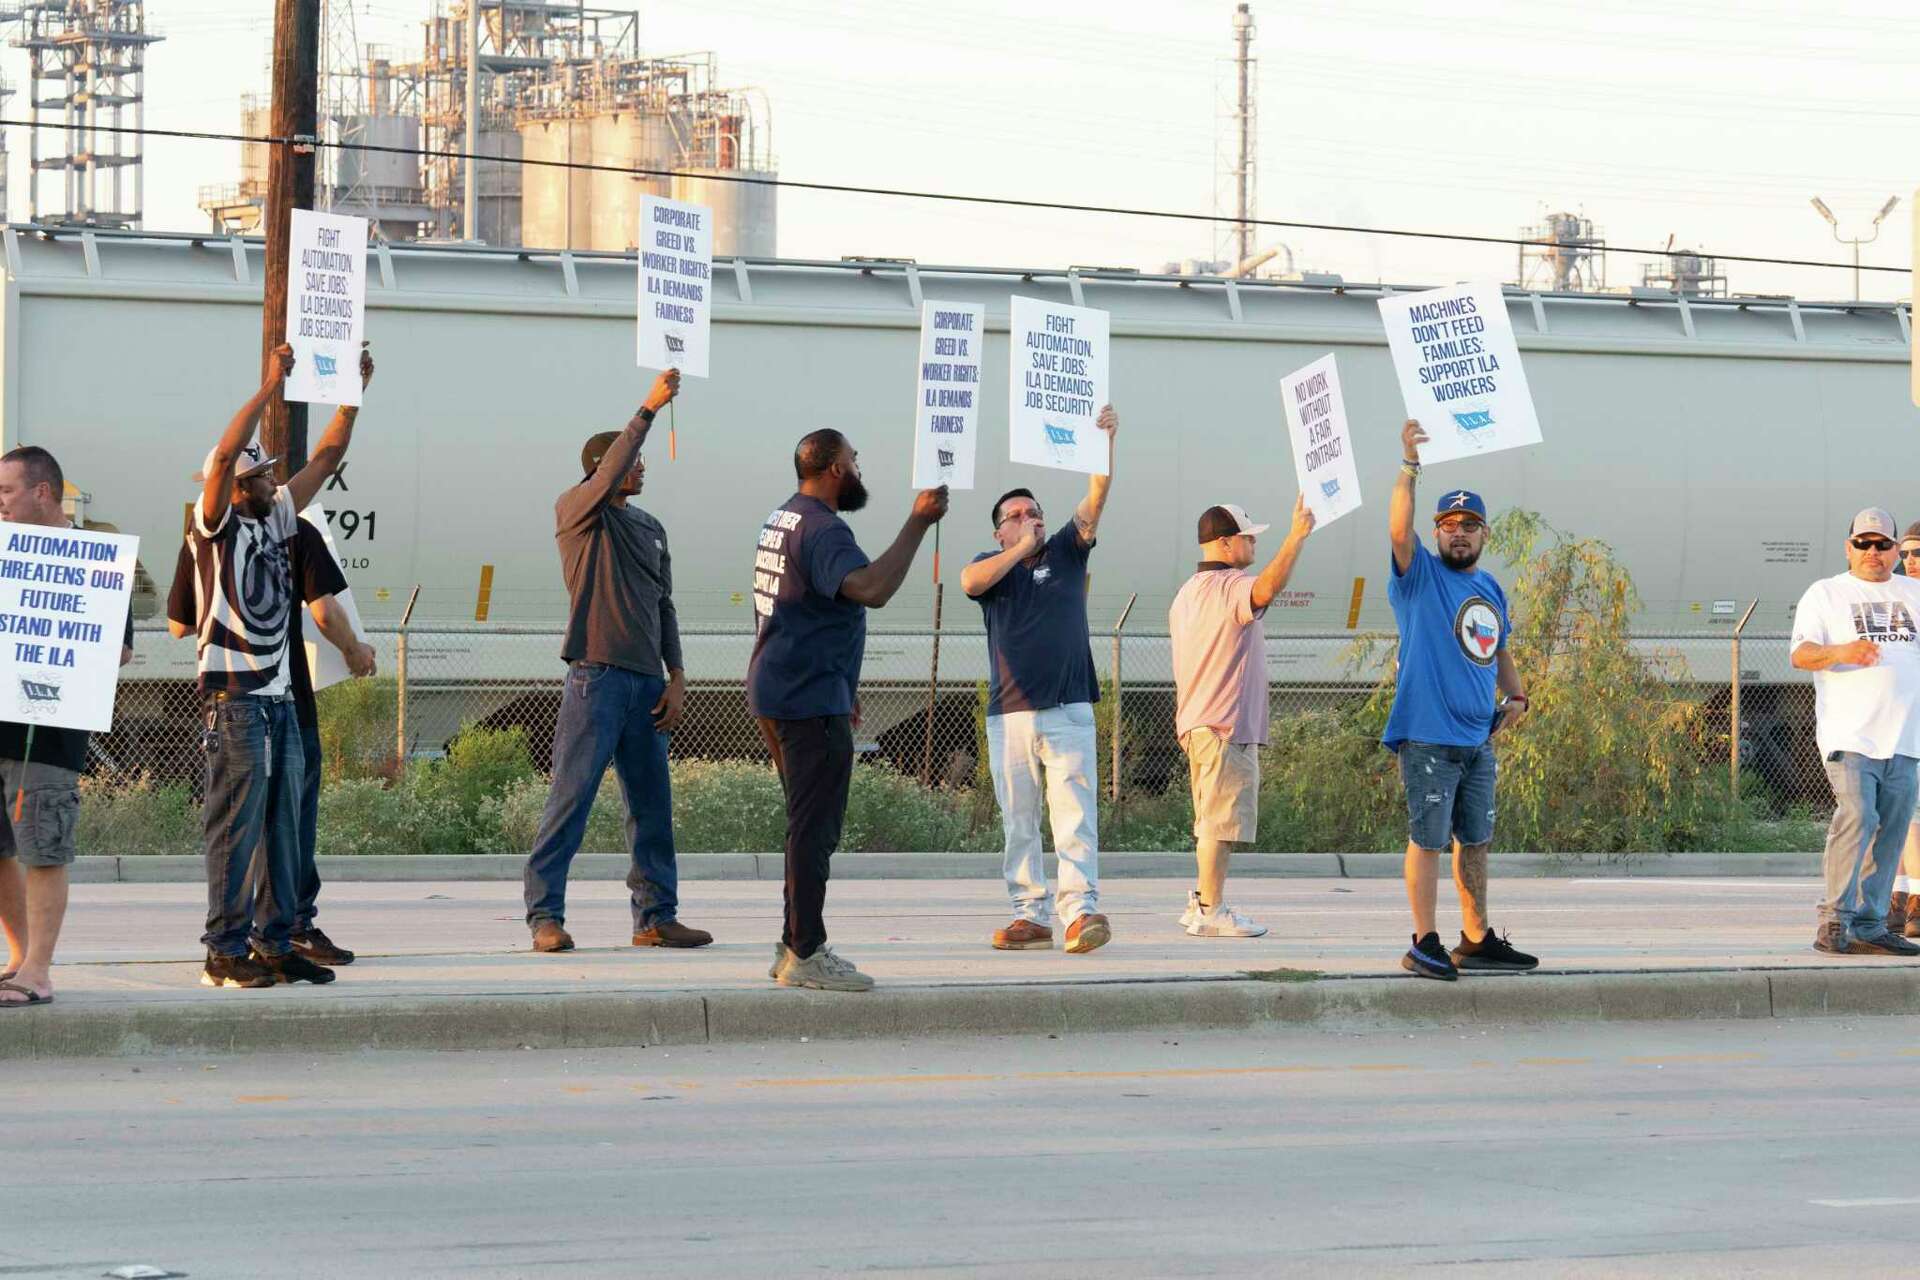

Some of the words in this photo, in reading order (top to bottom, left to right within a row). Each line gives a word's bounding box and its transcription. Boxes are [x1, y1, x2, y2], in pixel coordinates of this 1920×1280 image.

[654, 206, 701, 231] CORPORATE
[317, 228, 340, 247] FIGHT
[656, 230, 681, 251] GREED
[683, 236, 696, 254] VS.
[302, 249, 354, 274] AUTOMATION,
[642, 251, 677, 273] WORKER
[679, 258, 710, 280] RIGHTS:
[305, 272, 326, 293] SAVE
[326, 276, 348, 295] JOBS:
[647, 276, 661, 294] ILA
[663, 279, 703, 302] DEMANDS
[300, 294, 313, 315] ILA
[314, 296, 352, 319] DEMANDS
[655, 302, 694, 324] FAIRNESS
[1409, 296, 1477, 324] MACHINES
[299, 317, 313, 337] JOB
[314, 319, 352, 342] SECURITY
[934, 311, 974, 332] CORPORATE
[1046, 314, 1075, 334] FIGHT
[1411, 322, 1450, 344] DON'T
[1451, 315, 1485, 337] FEED
[935, 337, 956, 356] GREED
[1422, 336, 1486, 363] FAMILIES:
[922, 363, 952, 382] WORKER
[953, 364, 979, 383] RIGHTS:
[1032, 352, 1058, 373] SAVE
[1060, 357, 1087, 377] JOBS:
[1418, 358, 1477, 384] SUPPORT
[1479, 354, 1500, 373] ILA
[1025, 371, 1041, 390] ILA
[1044, 373, 1094, 397] DEMANDS
[1295, 381, 1307, 403] NO
[1305, 370, 1329, 398] WORK
[1432, 376, 1496, 403] WORKERS
[925, 389, 937, 407] ILA
[938, 389, 972, 408] DEMANDS
[1024, 391, 1043, 410] JOB
[1045, 394, 1094, 417] SECURITY
[1299, 393, 1333, 426] WITHOUT
[931, 415, 964, 434] FAIRNESS
[1309, 426, 1317, 447] A
[1315, 418, 1332, 444] FAIR
[1305, 436, 1343, 472] CONTRACT
[8, 533, 118, 562] AUTOMATION
[91, 569, 124, 591] OUR
[20, 588, 87, 614] FUTURE:
[0, 613, 52, 637] STAND
[58, 620, 102, 643] WITH
[1850, 601, 1917, 634] ILA
[15, 642, 43, 664] THE
[48, 648, 75, 668] ILA
